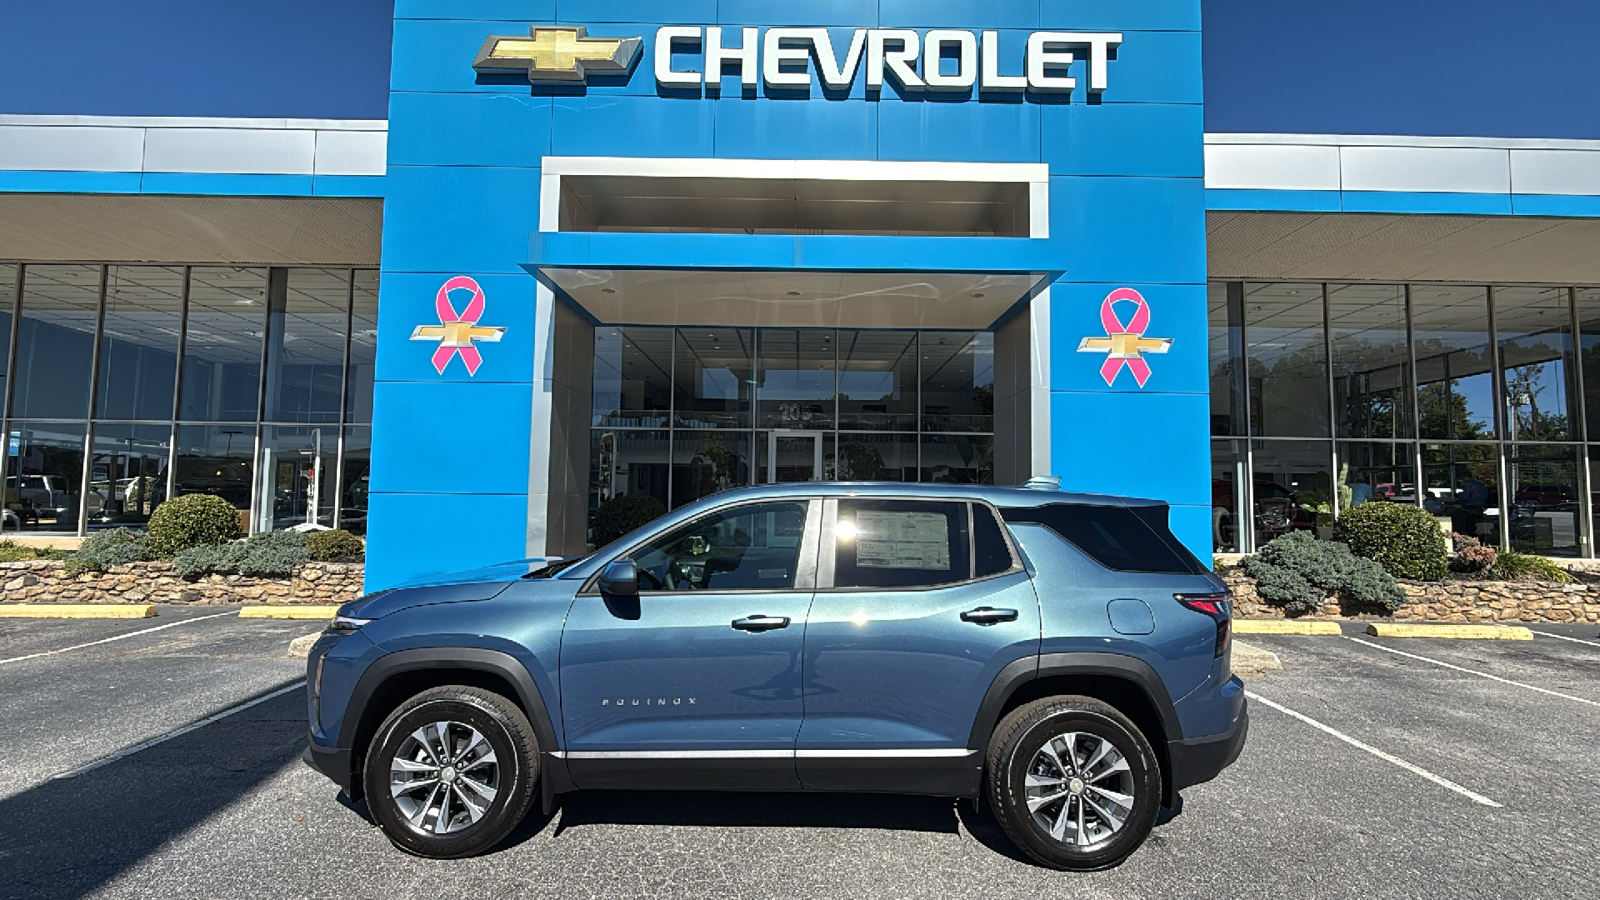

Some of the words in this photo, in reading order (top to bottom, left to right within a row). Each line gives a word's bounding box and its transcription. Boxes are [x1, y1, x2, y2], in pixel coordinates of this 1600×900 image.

[654, 26, 1123, 92] CHEVROLET
[779, 403, 812, 421] 205
[601, 697, 697, 706] EQUINOX
